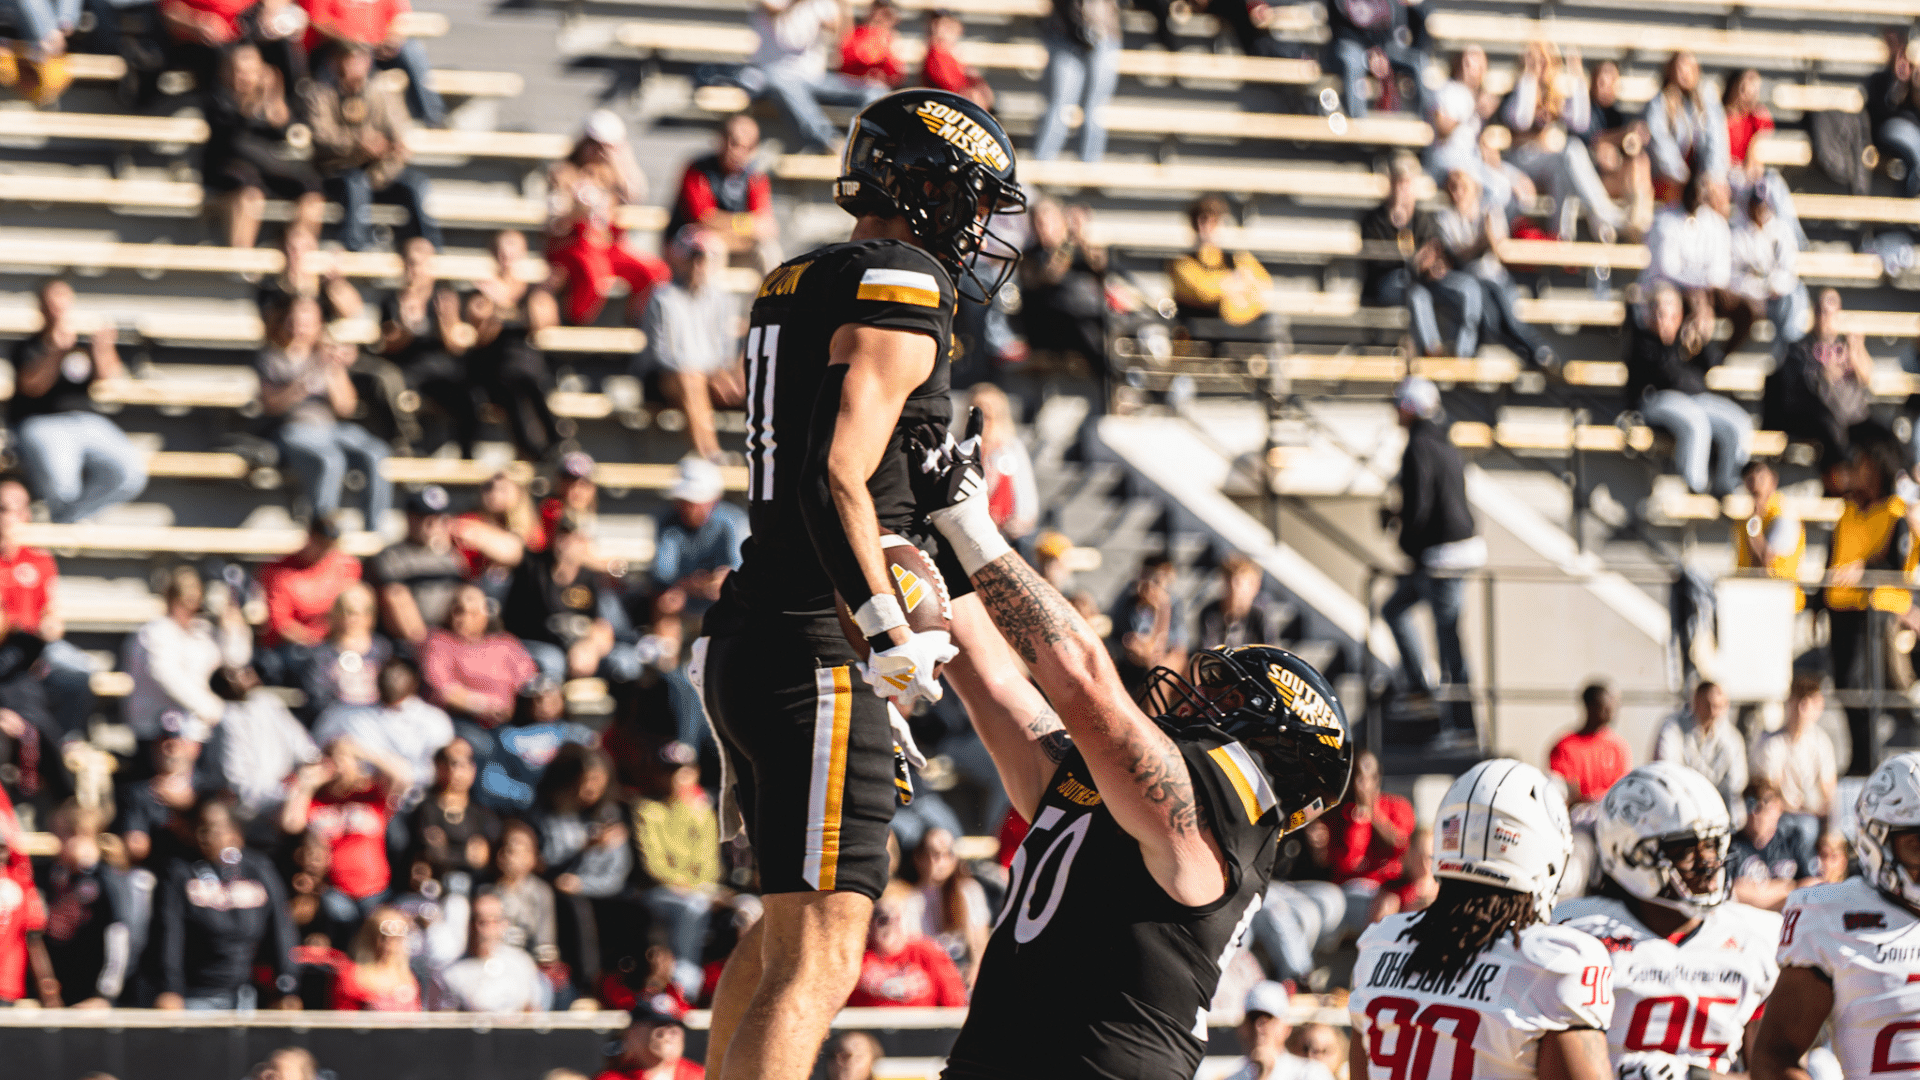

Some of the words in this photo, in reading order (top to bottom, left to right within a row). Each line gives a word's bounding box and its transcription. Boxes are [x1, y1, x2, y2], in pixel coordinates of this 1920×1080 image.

[916, 100, 1011, 171] SOUTHERN
[937, 122, 986, 157] MISS
[746, 325, 781, 500] 11
[1458, 963, 1500, 1001] JR.
